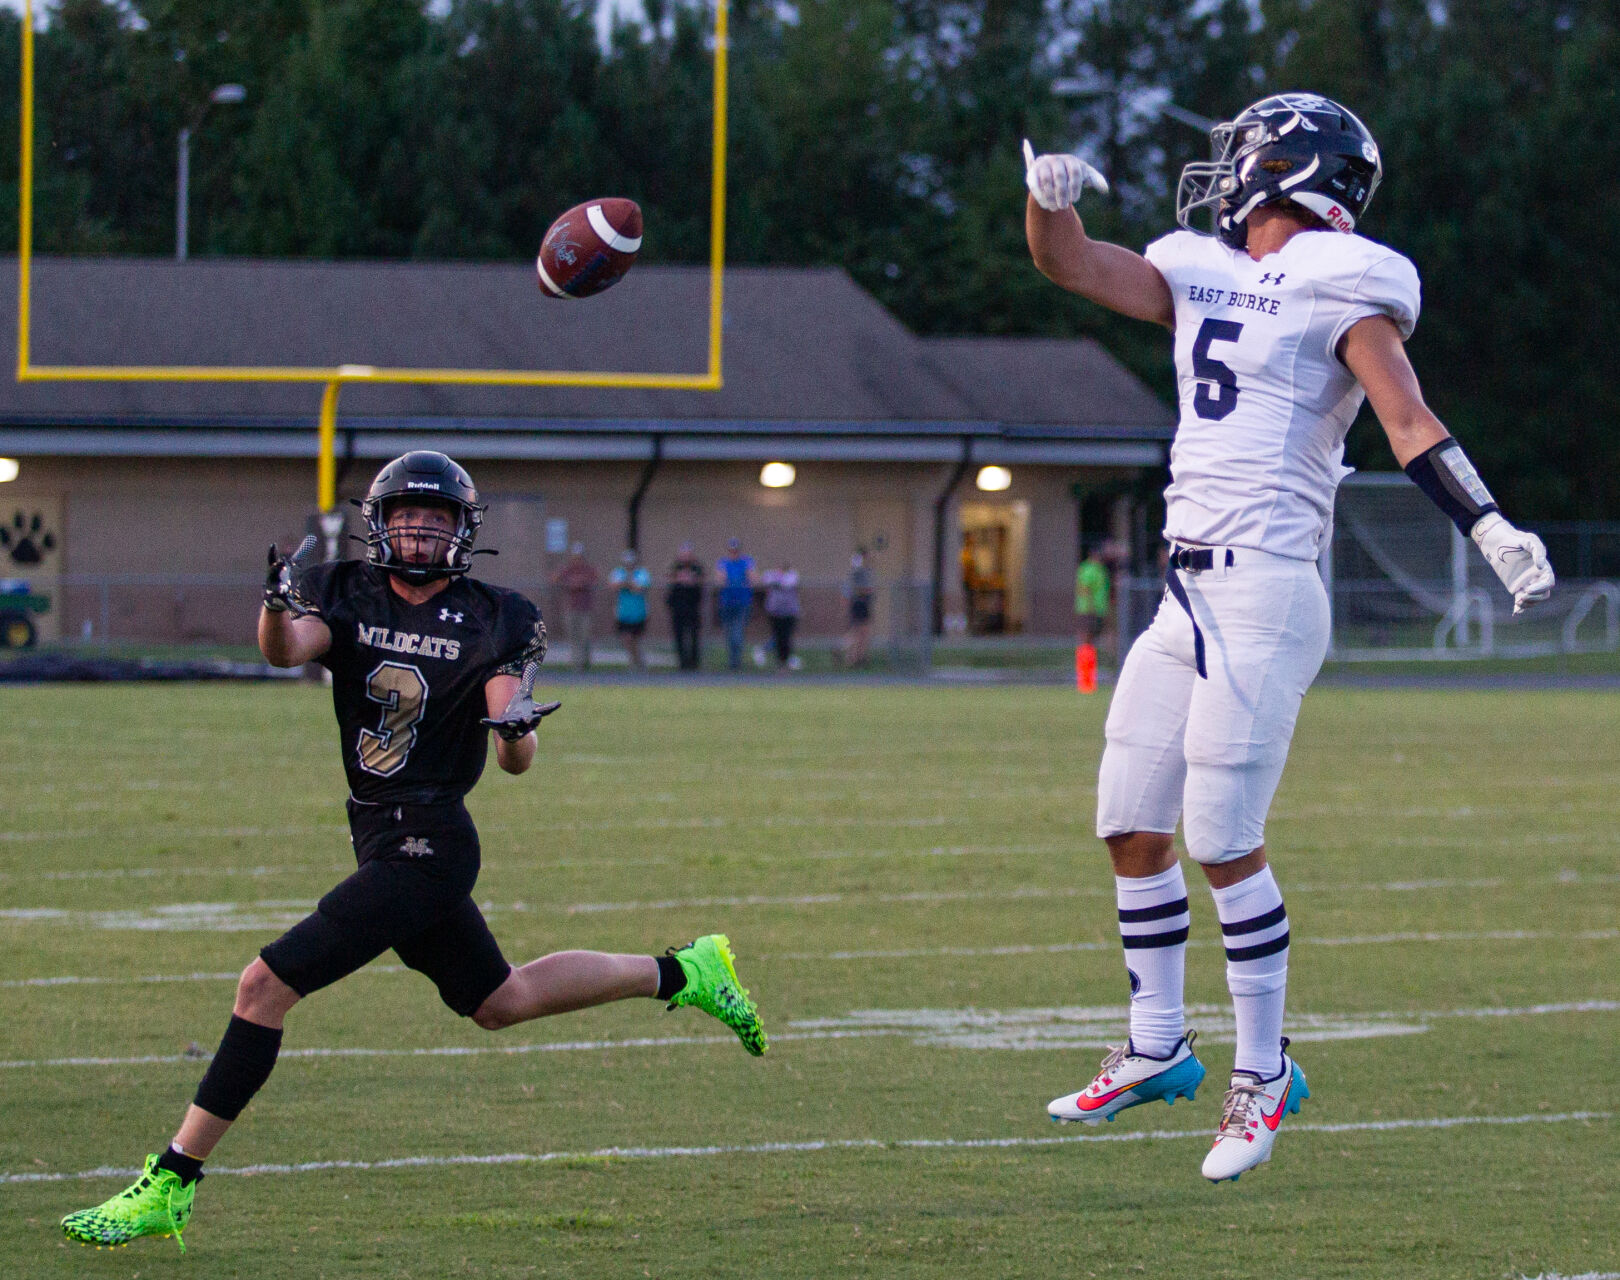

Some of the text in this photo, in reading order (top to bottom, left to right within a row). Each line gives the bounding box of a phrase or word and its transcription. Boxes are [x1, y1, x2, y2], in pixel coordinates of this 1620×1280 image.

[1189, 285, 1281, 316] EAST BURKE
[1192, 317, 1244, 422] 5
[407, 482, 440, 491] Riddell
[358, 622, 461, 660] WILDCATS
[356, 660, 429, 777] 3
